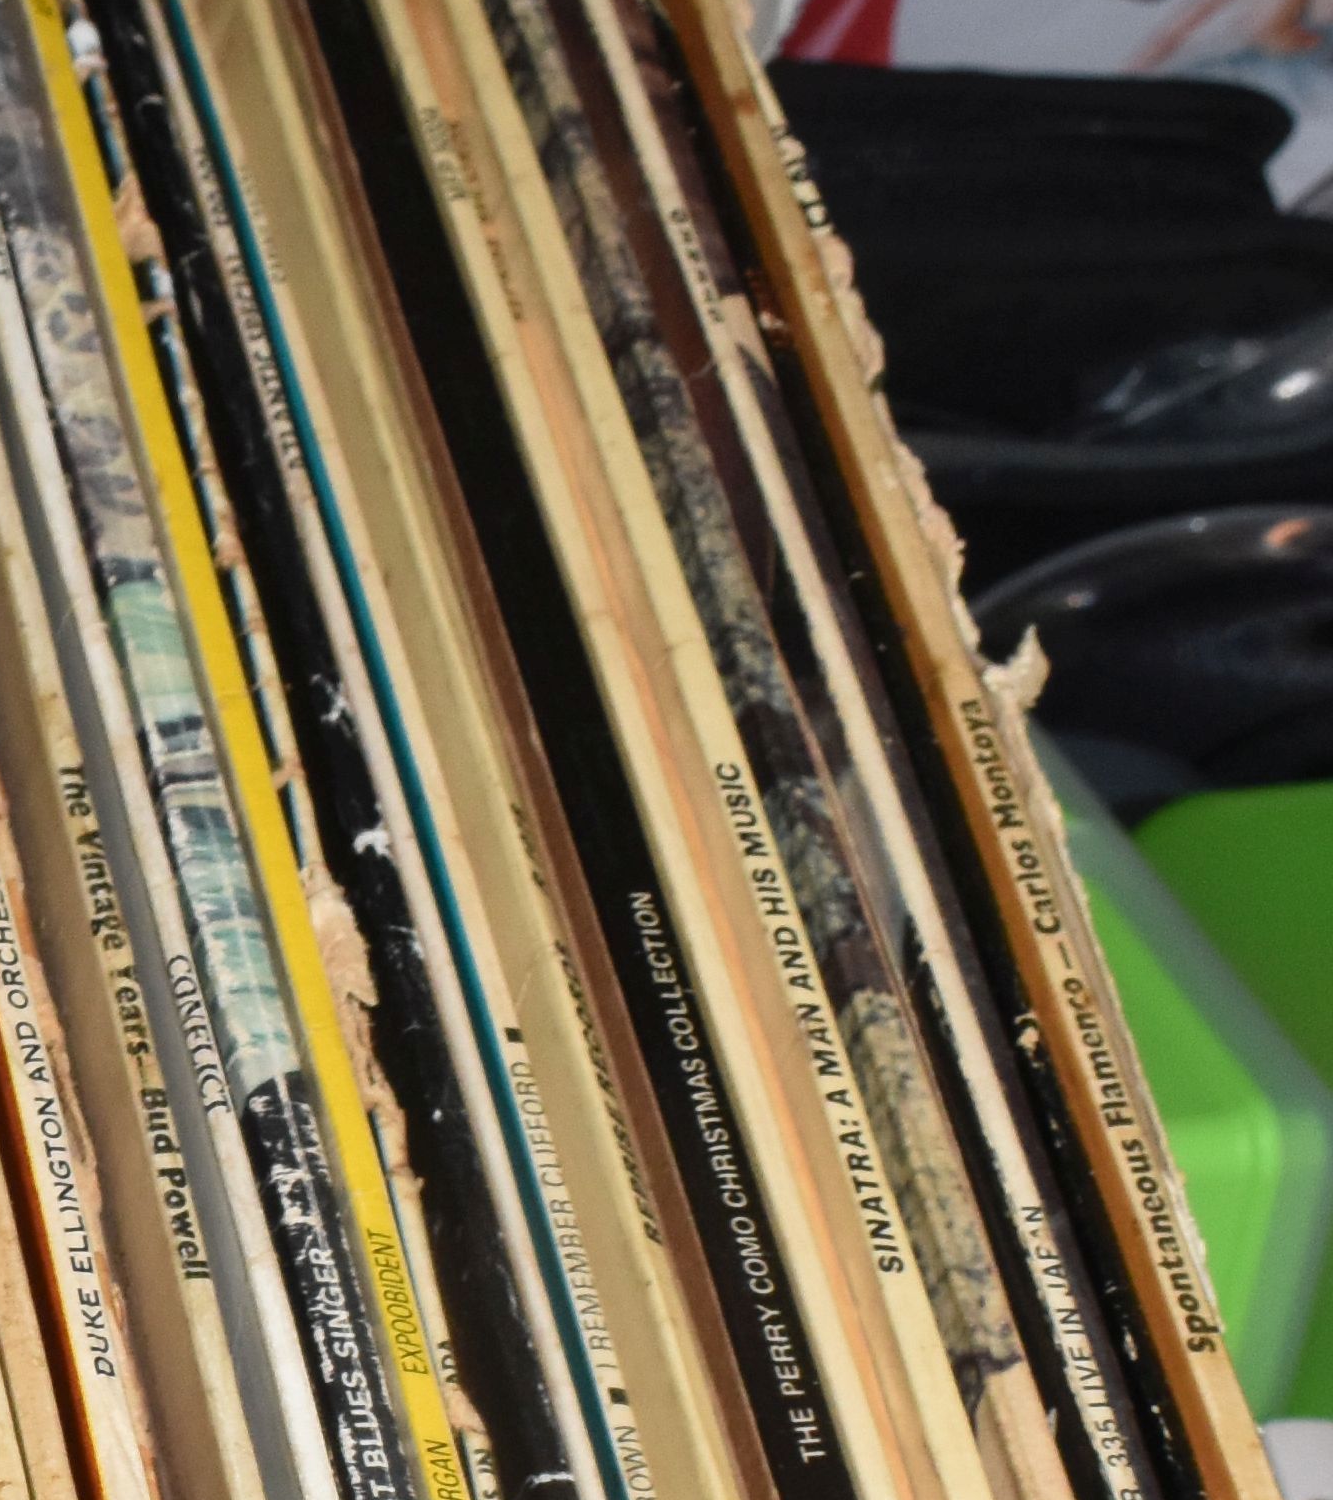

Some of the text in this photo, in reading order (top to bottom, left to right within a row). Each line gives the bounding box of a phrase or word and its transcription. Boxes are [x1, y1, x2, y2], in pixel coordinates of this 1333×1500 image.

[627, 889, 701, 1051] COLLECTION
[714, 761, 908, 1274] SINATRA: MAN AND HIS MUSIC
[955, 697, 1229, 1354] Spontaneous Flamenco Carlos Montoya
[508, 1060, 566, 1186] CLIFFORD
[679, 1057, 750, 1208] CHRISTMAS
[14, 1017, 117, 1378] DUKE ELLINGTON AND
[156, 1167, 212, 1280] Powell
[728, 1214, 777, 1294] COMO
[307, 1246, 360, 1358] SINGER
[364, 1227, 431, 1375] EXPOOBIDENT
[755, 1303, 809, 1397] PERRY
[338, 1368, 388, 1468] BLUES
[787, 1407, 830, 1462] THE
